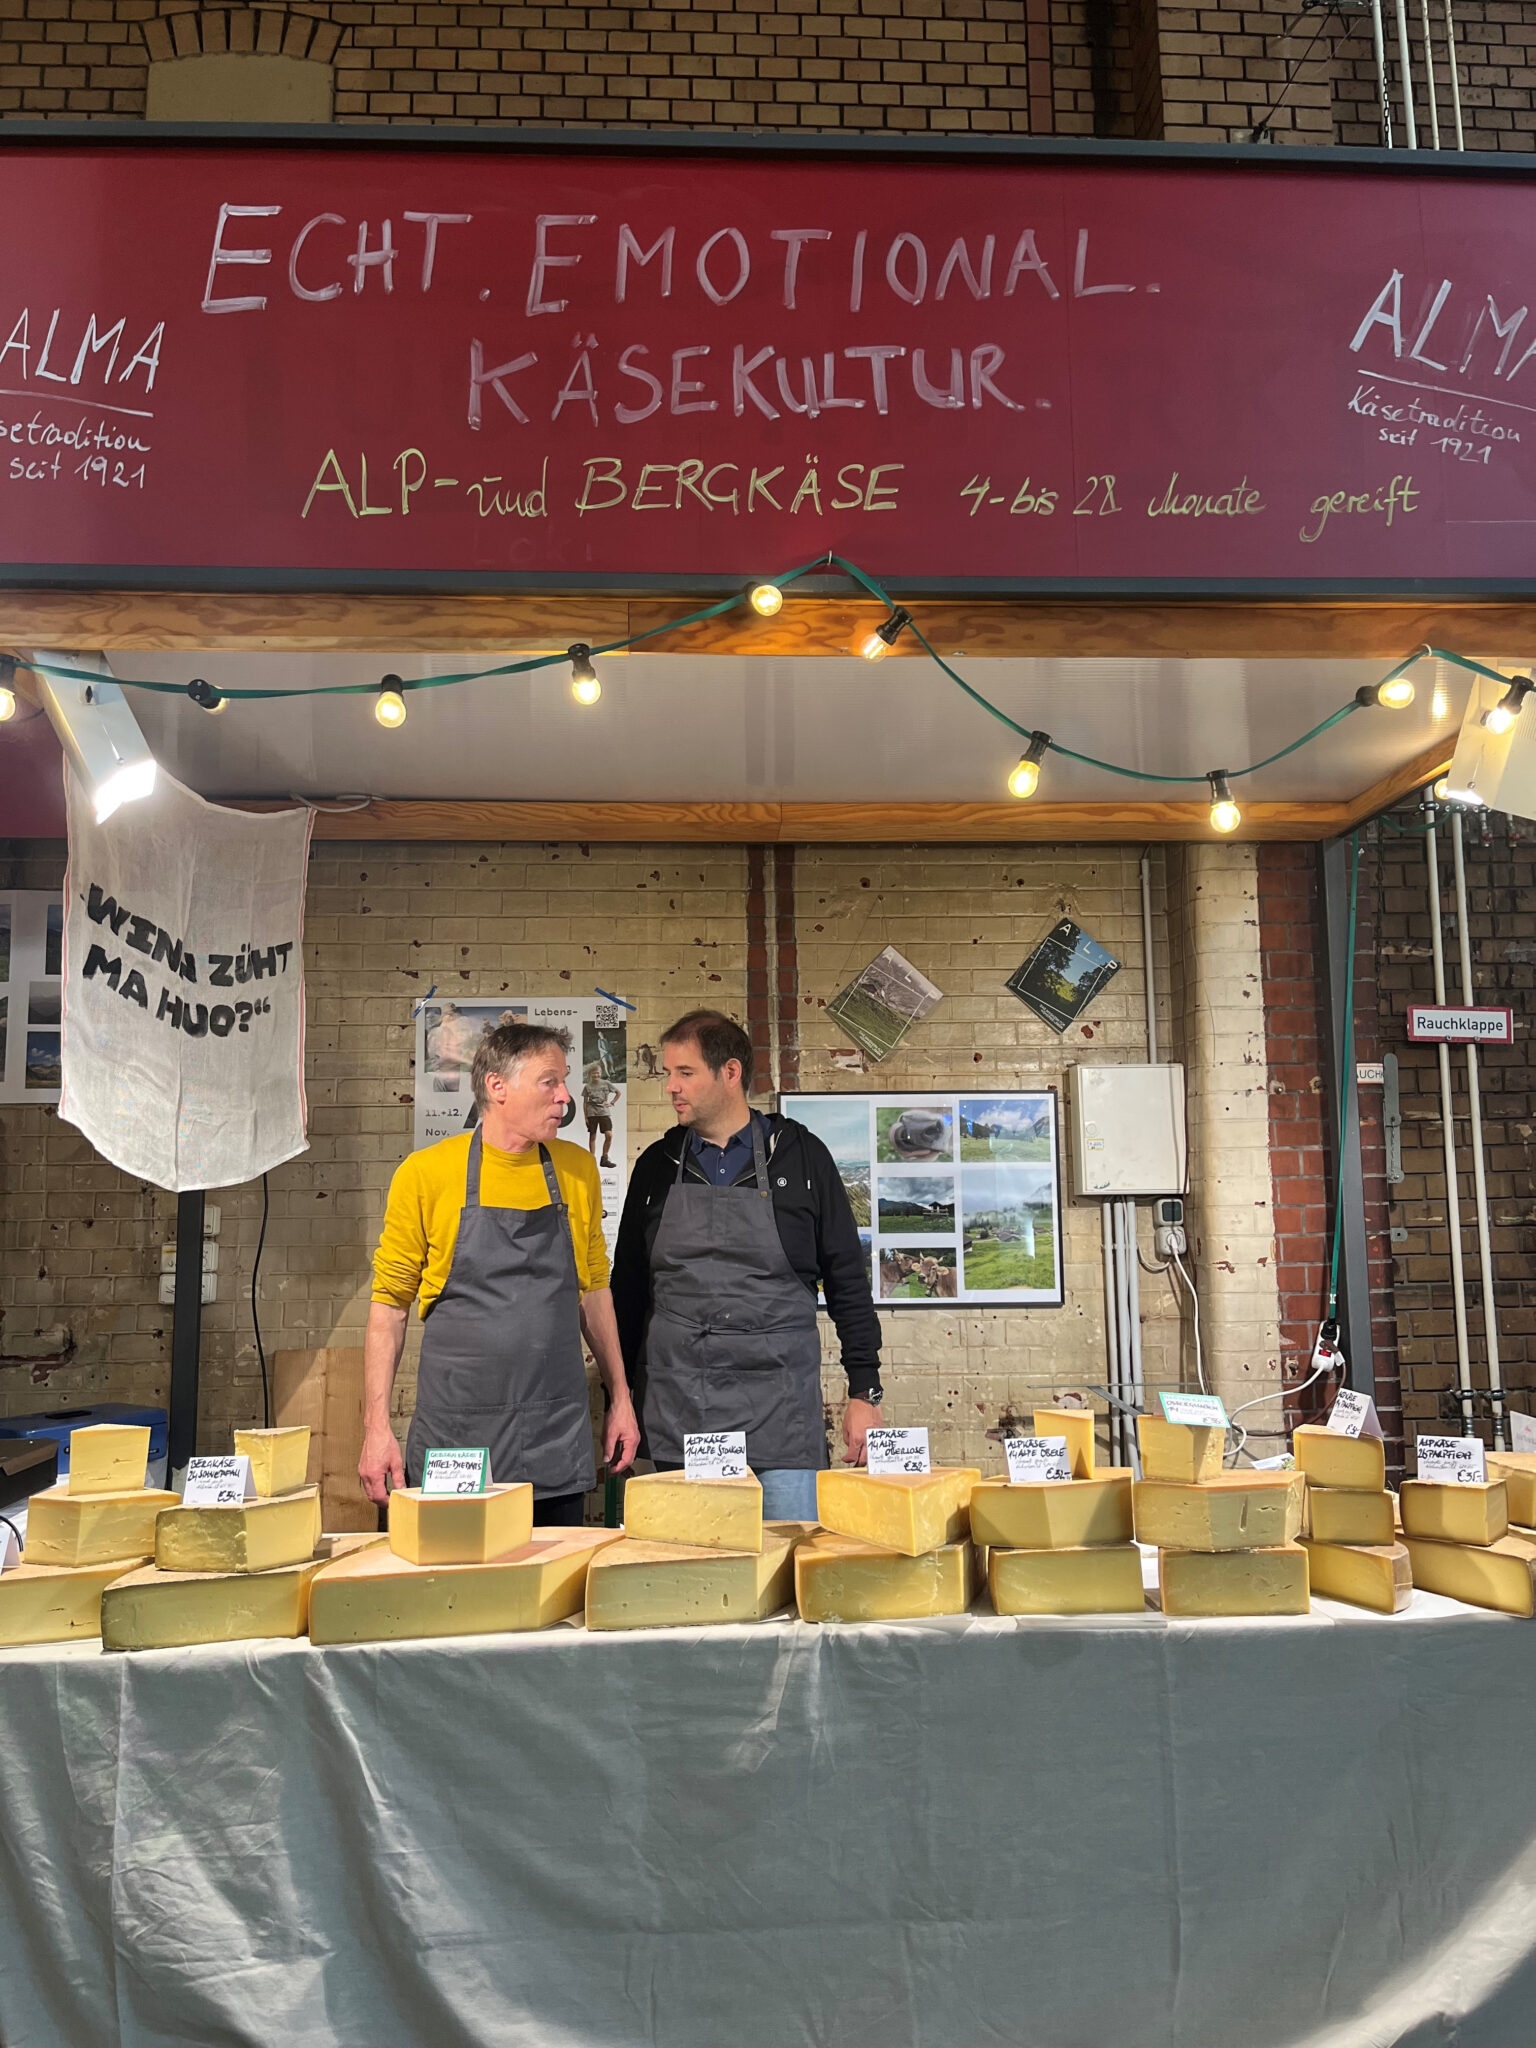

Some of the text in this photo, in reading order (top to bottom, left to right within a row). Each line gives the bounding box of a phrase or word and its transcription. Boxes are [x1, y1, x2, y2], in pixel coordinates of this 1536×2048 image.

[0, 307, 165, 393] ALMA
[1347, 385, 1520, 442] Käsetradition
[1378, 427, 1492, 464] seit 1921
[9, 450, 146, 489] seit 1921
[575, 453, 905, 518] BERGKÄSE
[1072, 474, 1122, 516] 28
[1299, 475, 1420, 542] gereift
[83, 944, 148, 1009] MA
[209, 942, 293, 987] ZÜHT
[534, 1008, 578, 1016] Lebens-
[1416, 1016, 1504, 1034] Rauchklappe
[426, 1128, 450, 1136] Nov.
[868, 1429, 909, 1439] ALPKÄSE
[190, 1456, 237, 1469] BERGKÄSE
